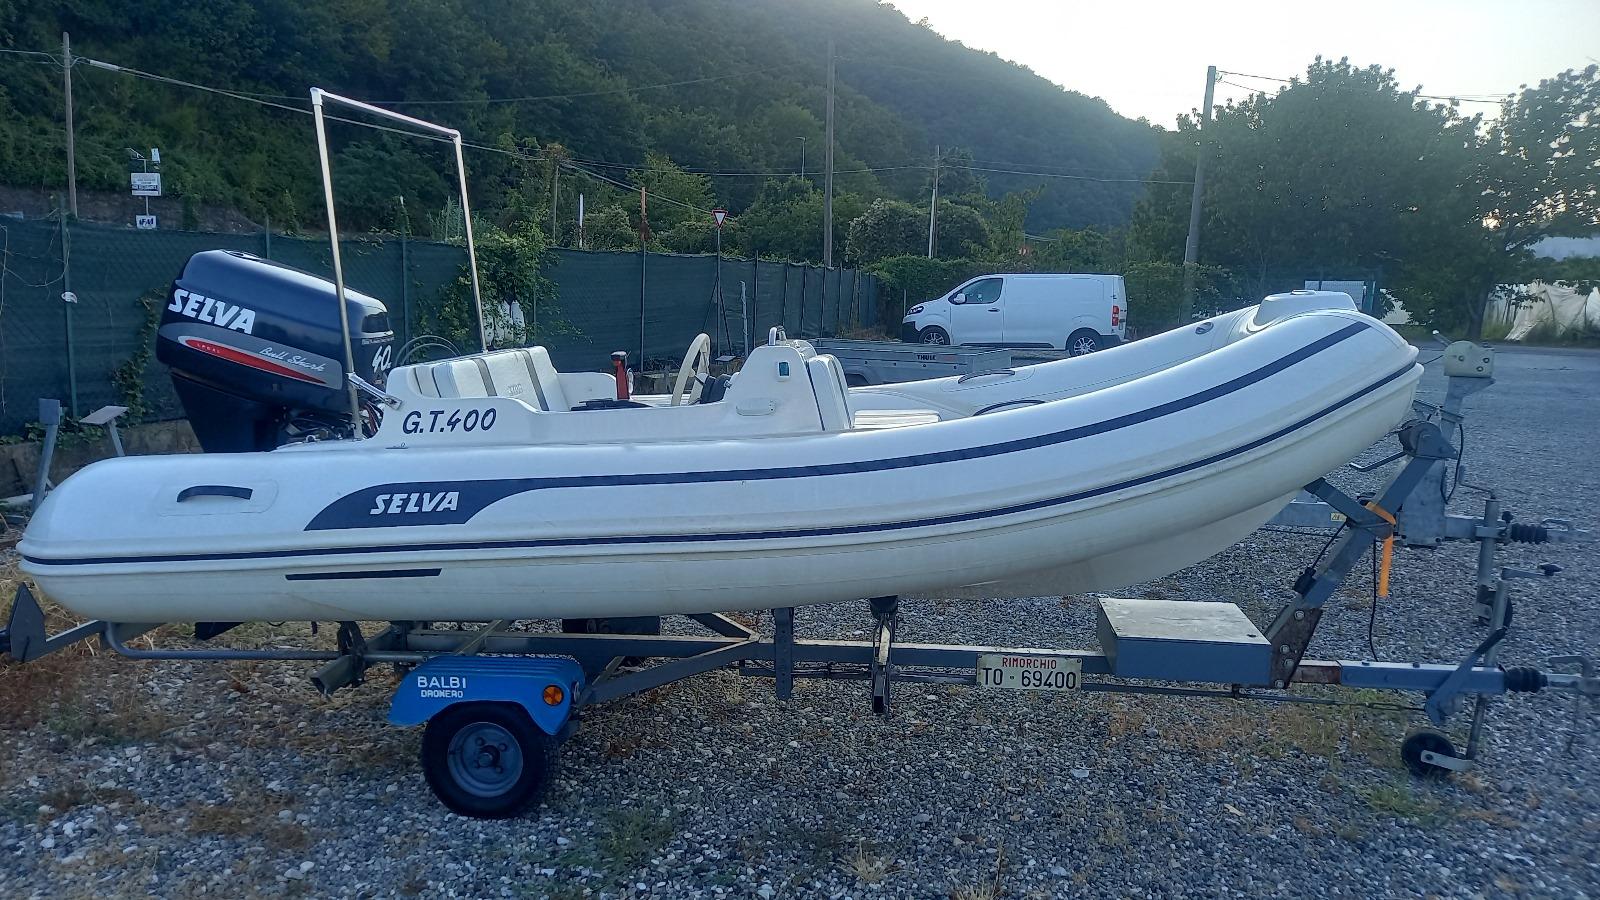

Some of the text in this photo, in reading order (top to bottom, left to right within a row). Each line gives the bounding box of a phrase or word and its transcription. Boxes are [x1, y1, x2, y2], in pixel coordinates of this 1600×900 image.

[167, 288, 256, 335] SELVA
[259, 346, 328, 372] Bull Shark
[369, 491, 460, 515] SELVA
[1002, 656, 1057, 670] RIMORCHIO
[417, 675, 467, 689] BALBI
[1021, 669, 1077, 690] 69400
[420, 688, 464, 699] DRONERO
